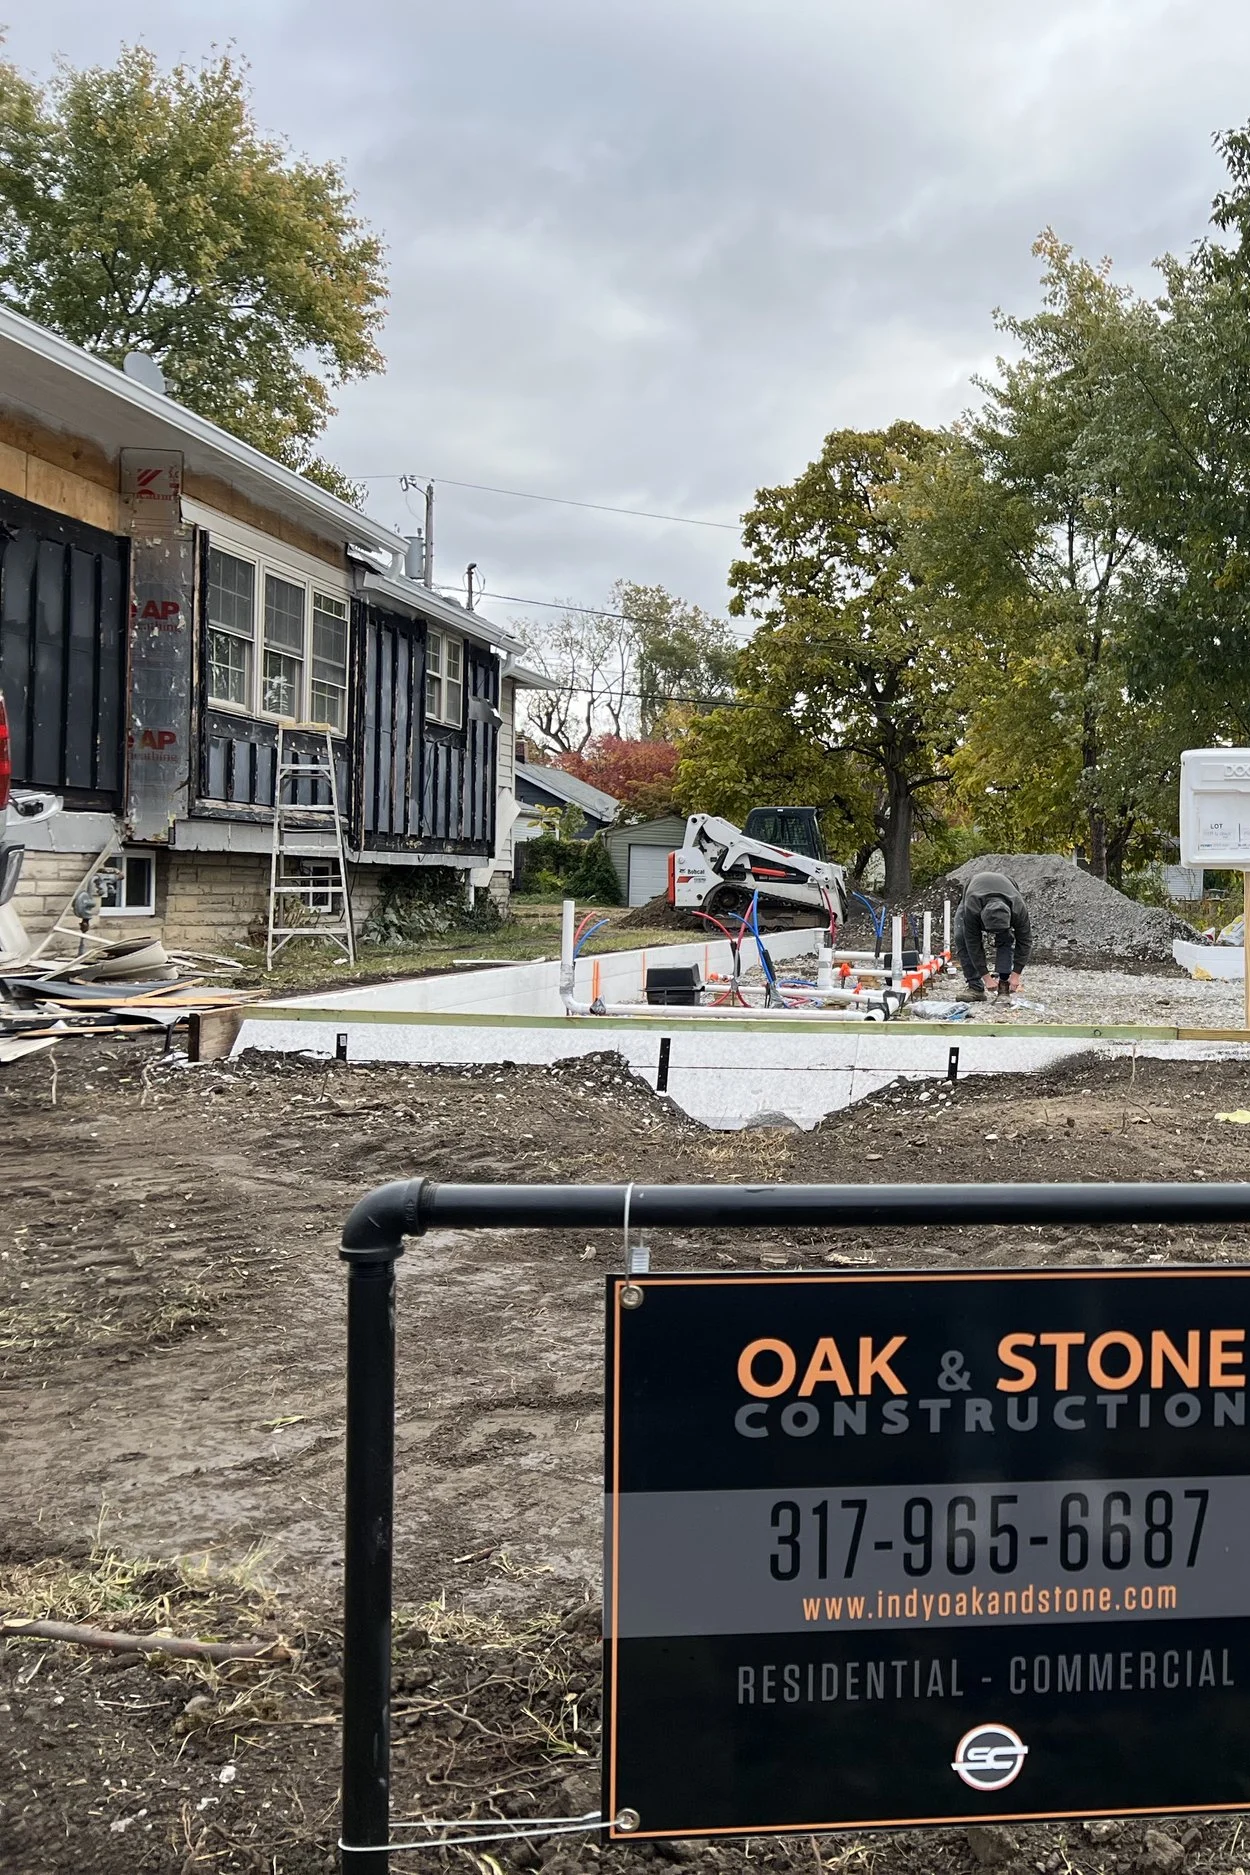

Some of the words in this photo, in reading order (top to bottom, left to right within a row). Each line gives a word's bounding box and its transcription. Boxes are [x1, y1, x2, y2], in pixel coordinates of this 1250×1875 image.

[141, 600, 180, 620] AP
[737, 1336, 908, 1398] OAK
[937, 1350, 972, 1391] &
[996, 1329, 1246, 1392] STONE
[734, 1391, 1246, 1437] CONSTRUCTION
[769, 1488, 1210, 1582] 317-965-6687
[802, 1584, 1178, 1621] www.indyoakandstone.com
[737, 1658, 964, 1704] RESIDENTIAL
[1009, 1648, 1235, 1695] COMMERCIAL
